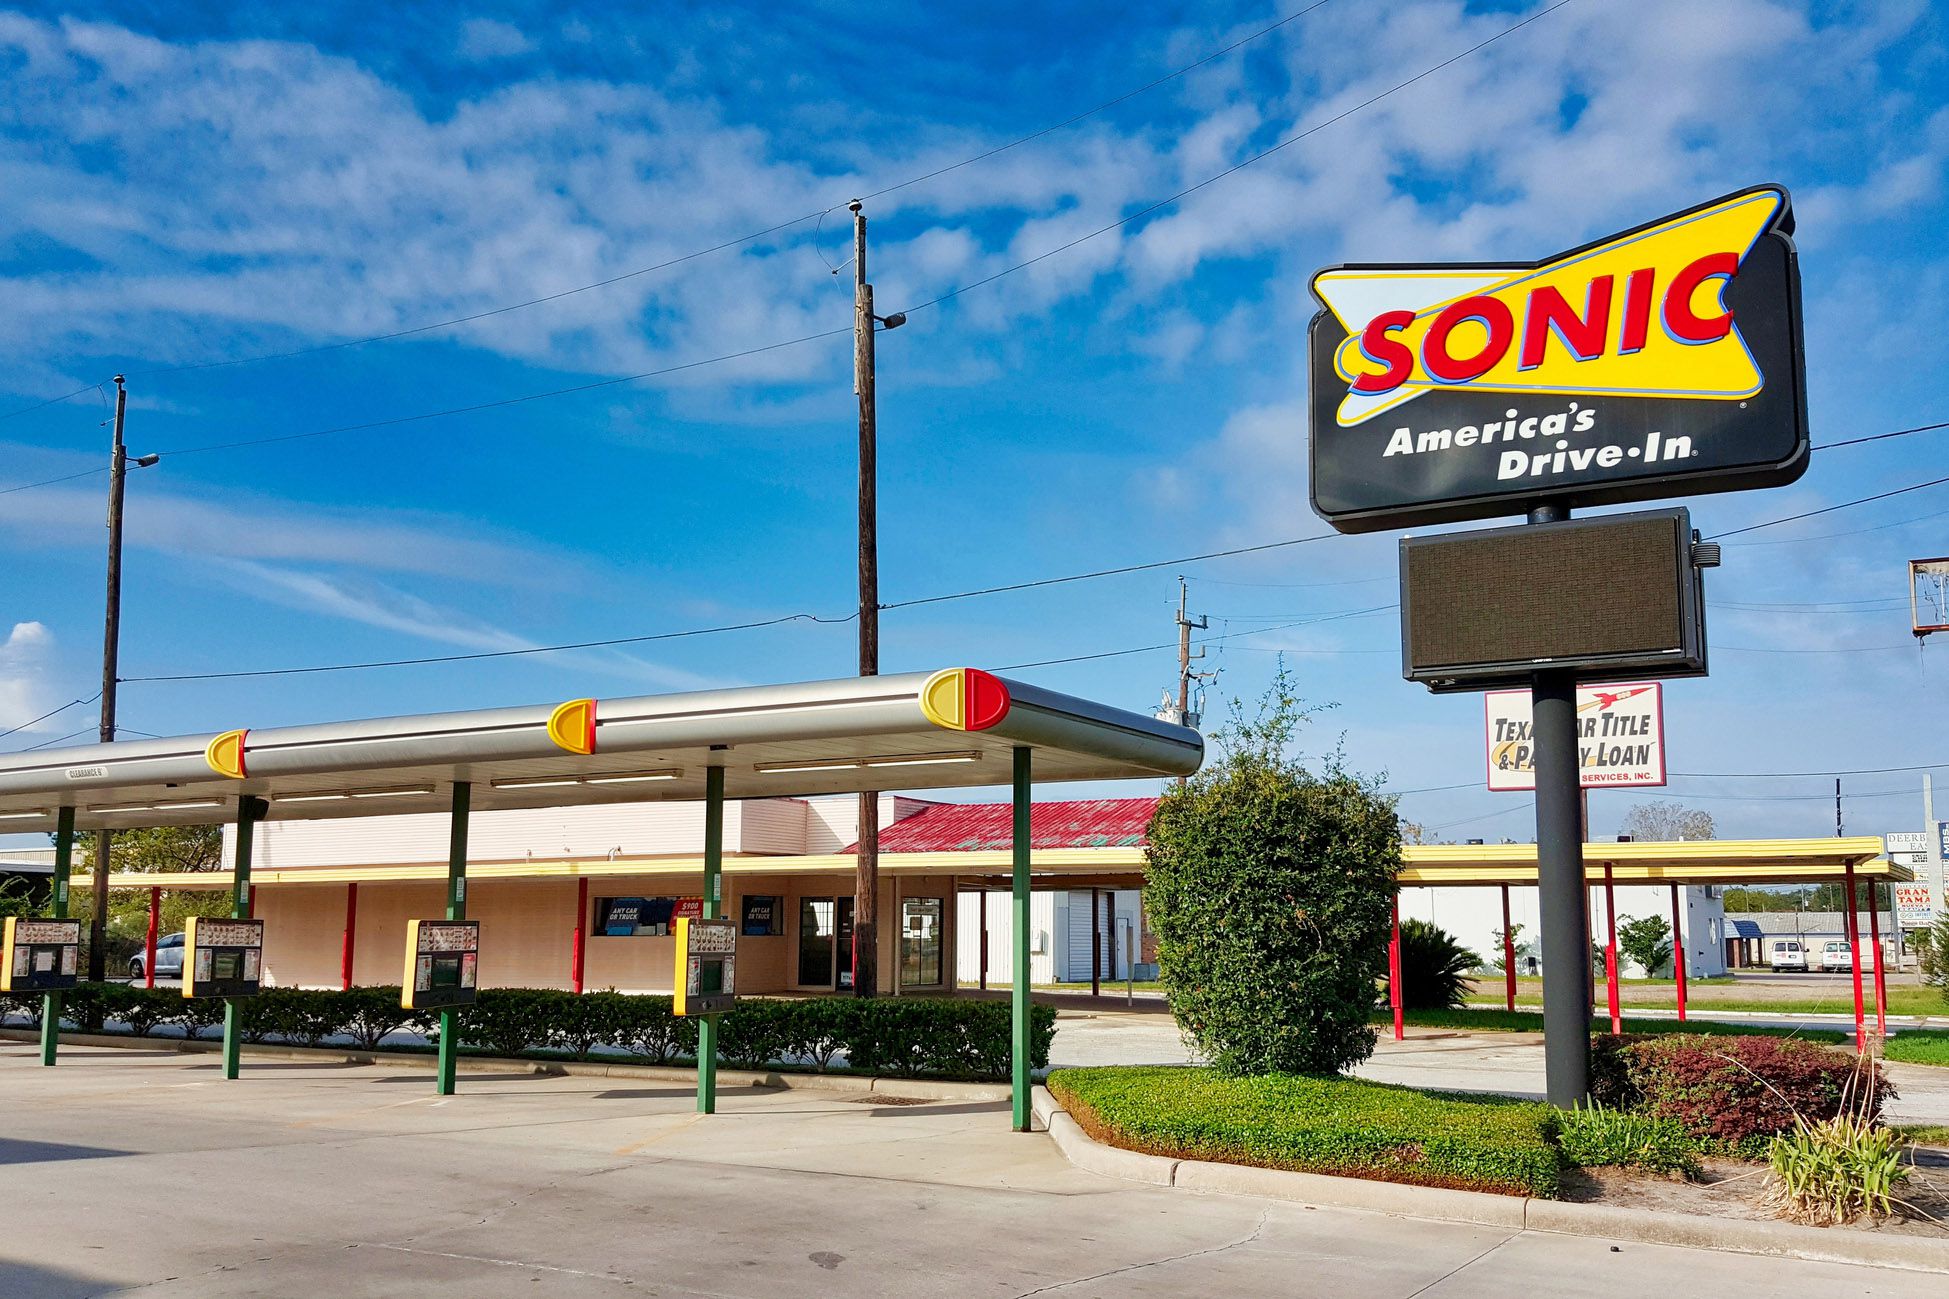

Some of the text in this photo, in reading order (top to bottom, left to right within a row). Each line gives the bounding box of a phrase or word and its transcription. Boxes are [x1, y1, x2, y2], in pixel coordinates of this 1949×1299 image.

[1348, 252, 1739, 395] SONIC
[1382, 402, 1596, 457] America's
[1601, 712, 1651, 737] TITLE
[1498, 754, 1509, 770] &
[1596, 742, 1650, 767] LOAN
[1582, 772, 1654, 782] SERVICES, INC.
